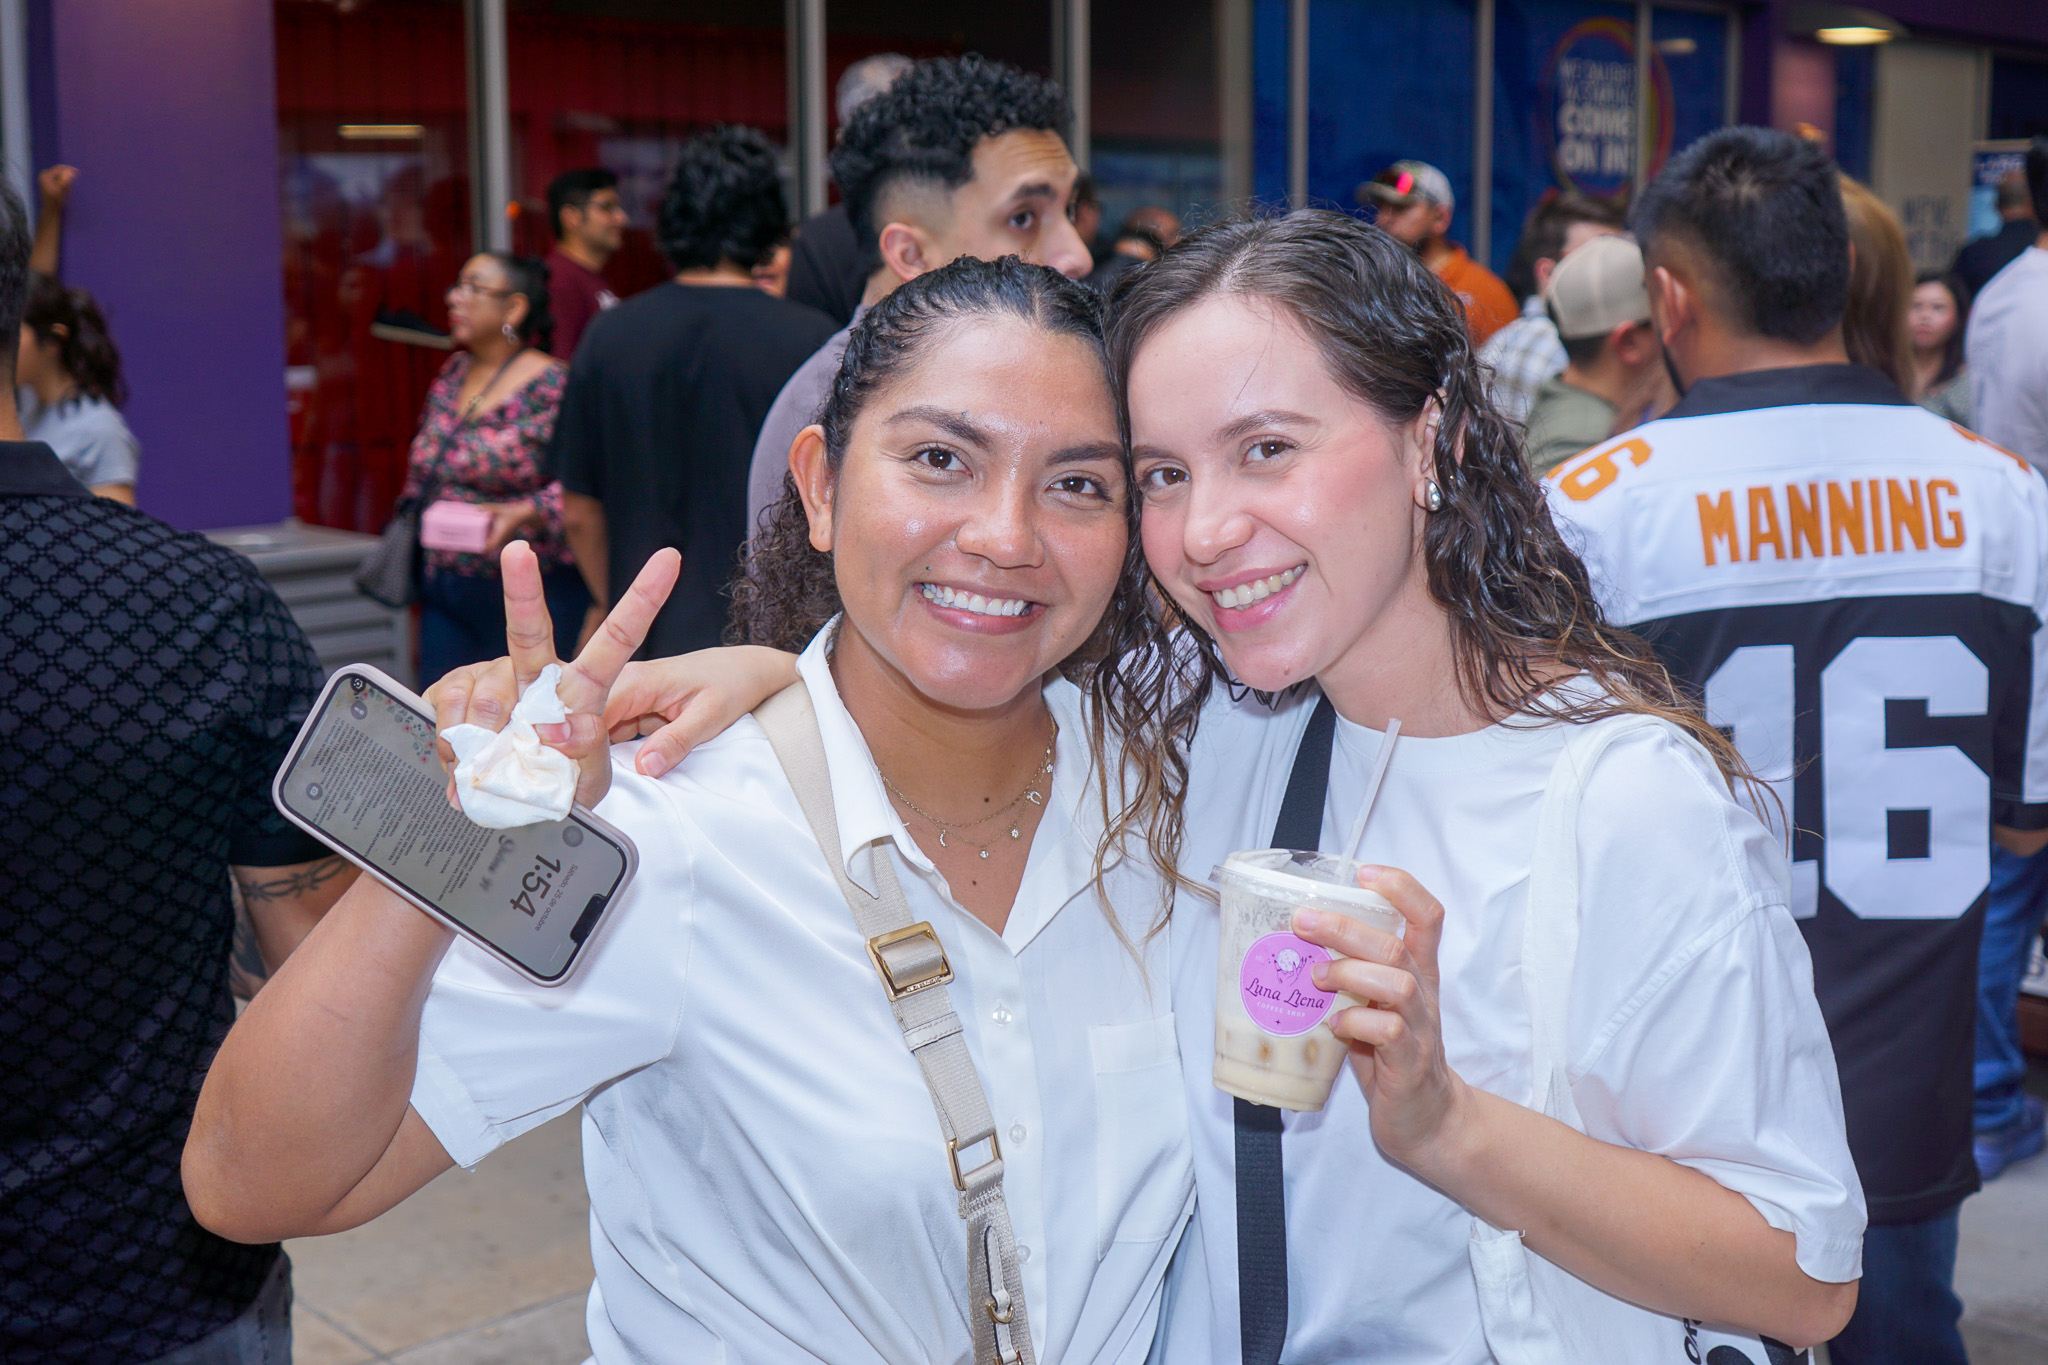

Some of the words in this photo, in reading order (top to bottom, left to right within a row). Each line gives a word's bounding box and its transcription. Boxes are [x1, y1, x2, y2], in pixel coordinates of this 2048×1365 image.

[1557, 101, 1632, 137] COME
[1558, 137, 1599, 172] ON
[1696, 479, 1967, 566] MANNING
[1705, 636, 1991, 919] 16
[509, 854, 561, 917] 1:54
[560, 863, 578, 888] Sábado,
[549, 898, 557, 907] de
[554, 888, 563, 899] 25
[534, 907, 552, 931] octubre
[1245, 977, 1281, 1001] Luna
[1283, 989, 1325, 1009] Llena
[1256, 1001, 1284, 1014] COFFEE
[1287, 1009, 1306, 1018] SHOP
